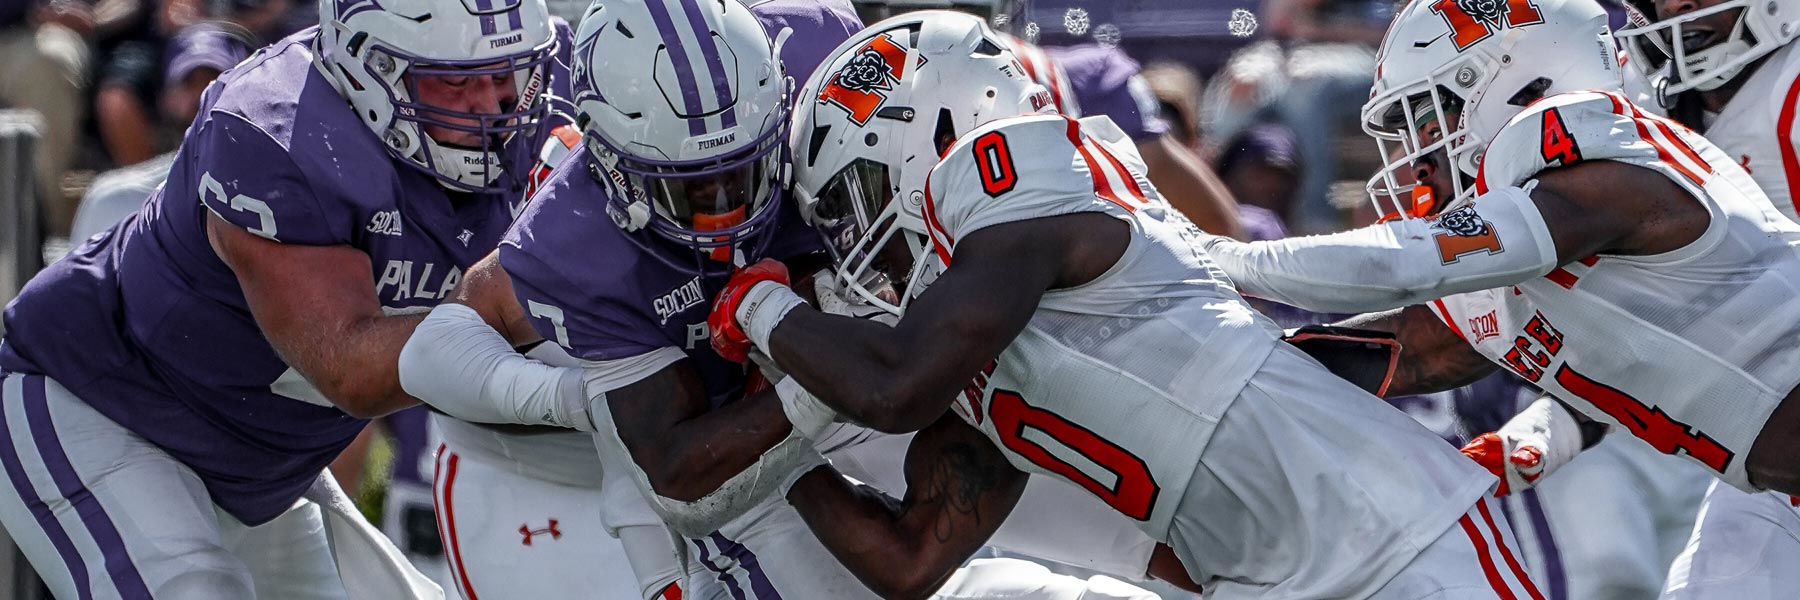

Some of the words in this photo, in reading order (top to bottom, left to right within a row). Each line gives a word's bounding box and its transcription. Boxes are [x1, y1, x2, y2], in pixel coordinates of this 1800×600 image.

[490, 34, 523, 49] FURMAN
[463, 156, 494, 165] Riddll
[697, 132, 736, 151] FURMAN
[1540, 106, 1584, 168] 4
[972, 130, 1018, 199] 0
[527, 299, 574, 350] 7
[653, 275, 706, 326] SOCON
[1553, 360, 1736, 475] 4
[987, 387, 1161, 522] 0
